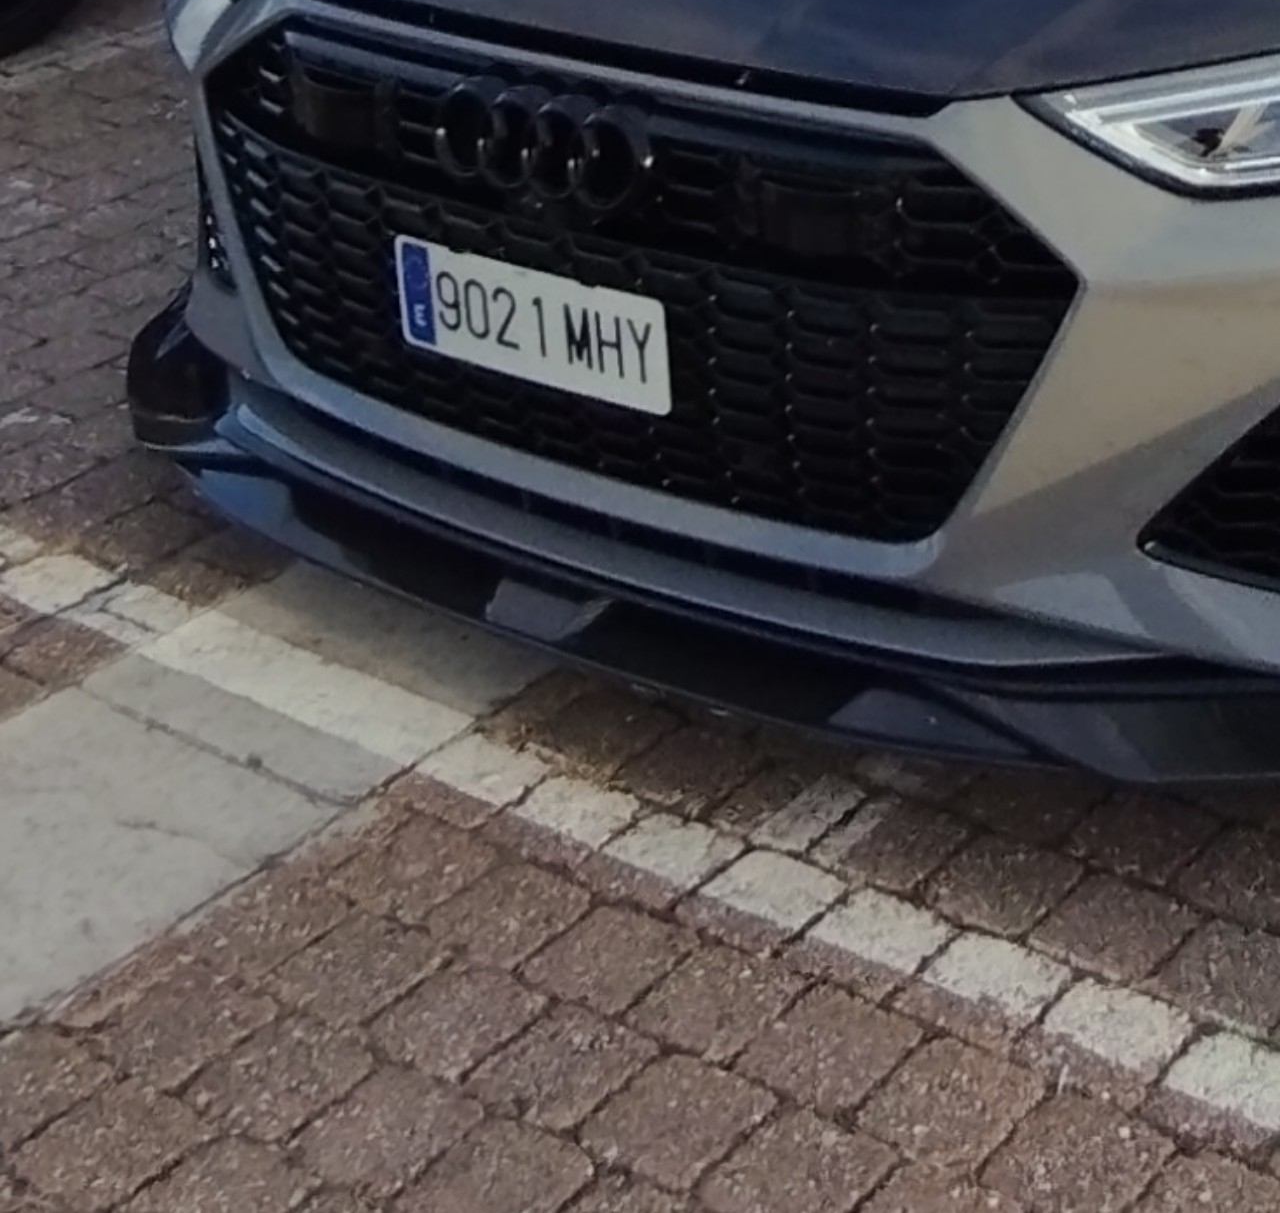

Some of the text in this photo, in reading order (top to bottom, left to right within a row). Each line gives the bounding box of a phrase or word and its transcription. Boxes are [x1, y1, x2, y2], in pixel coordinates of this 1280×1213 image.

[413, 304, 427, 327] E
[436, 271, 651, 384] 9021 MHY
